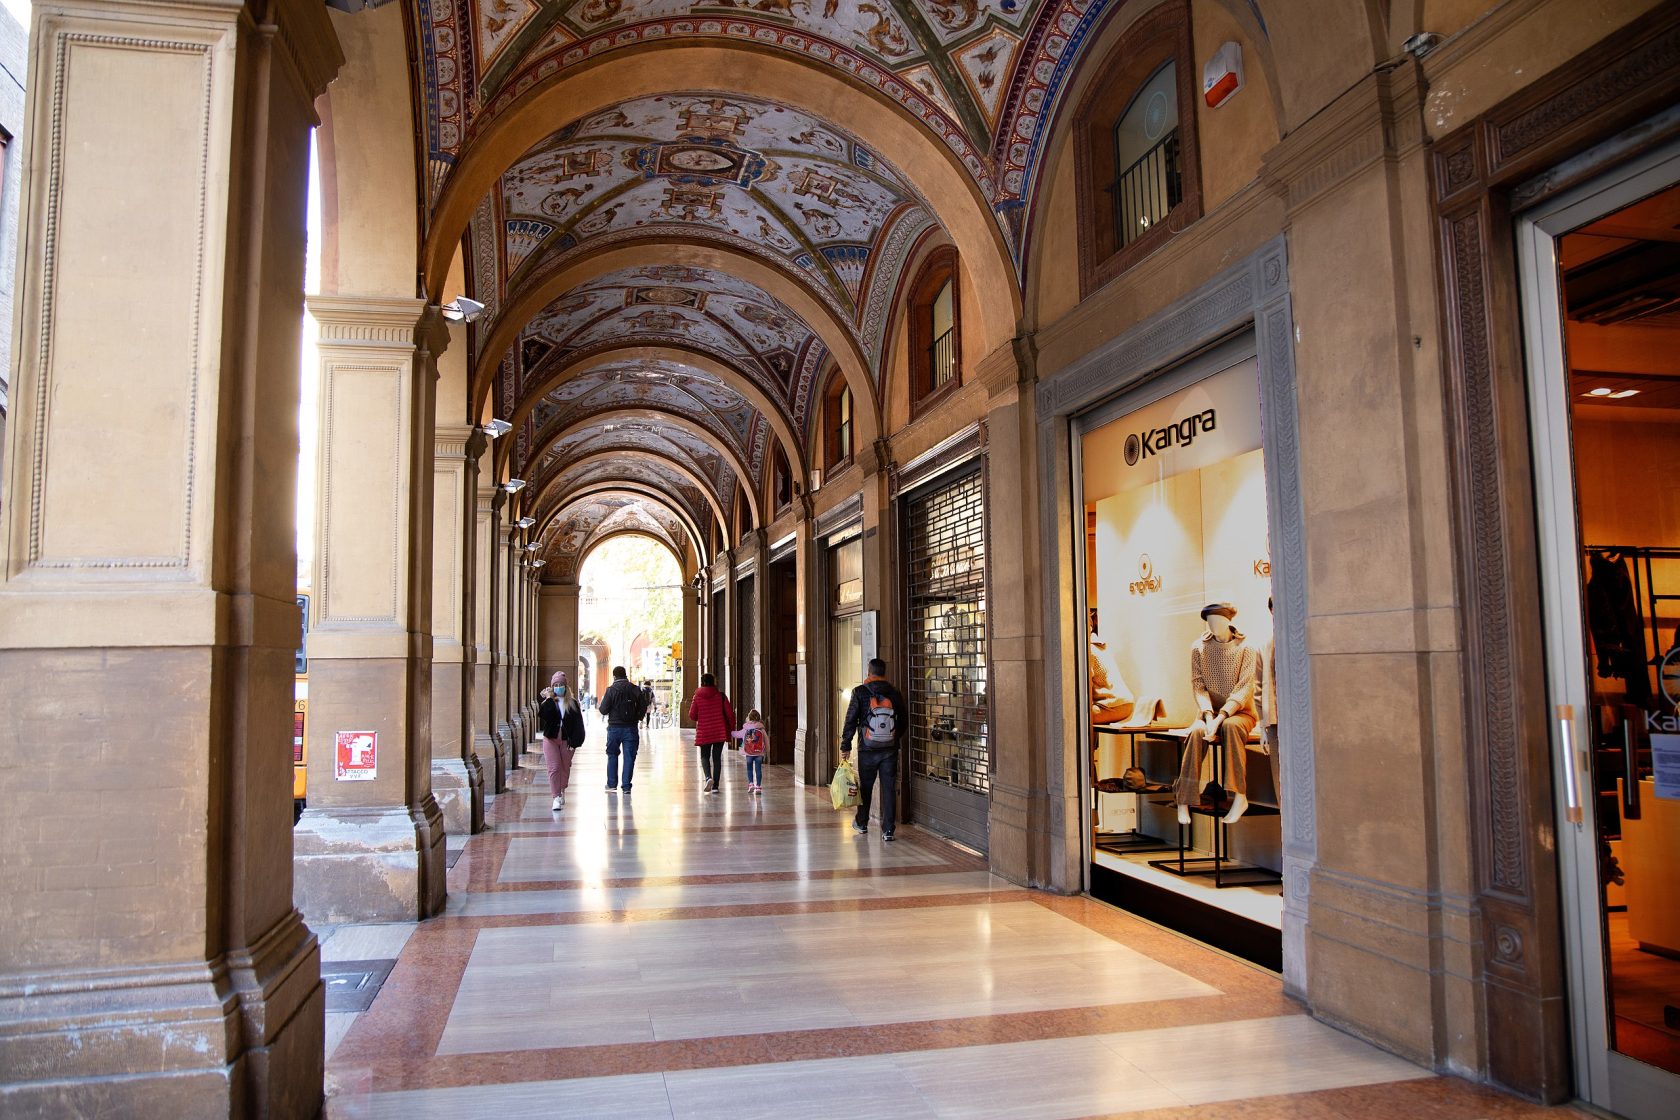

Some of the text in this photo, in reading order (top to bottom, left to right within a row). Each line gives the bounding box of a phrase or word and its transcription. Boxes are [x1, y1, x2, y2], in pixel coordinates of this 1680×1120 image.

[1141, 408, 1216, 459] Kangra
[295, 700, 305, 711] 6
[1644, 710, 1680, 731] Ka
